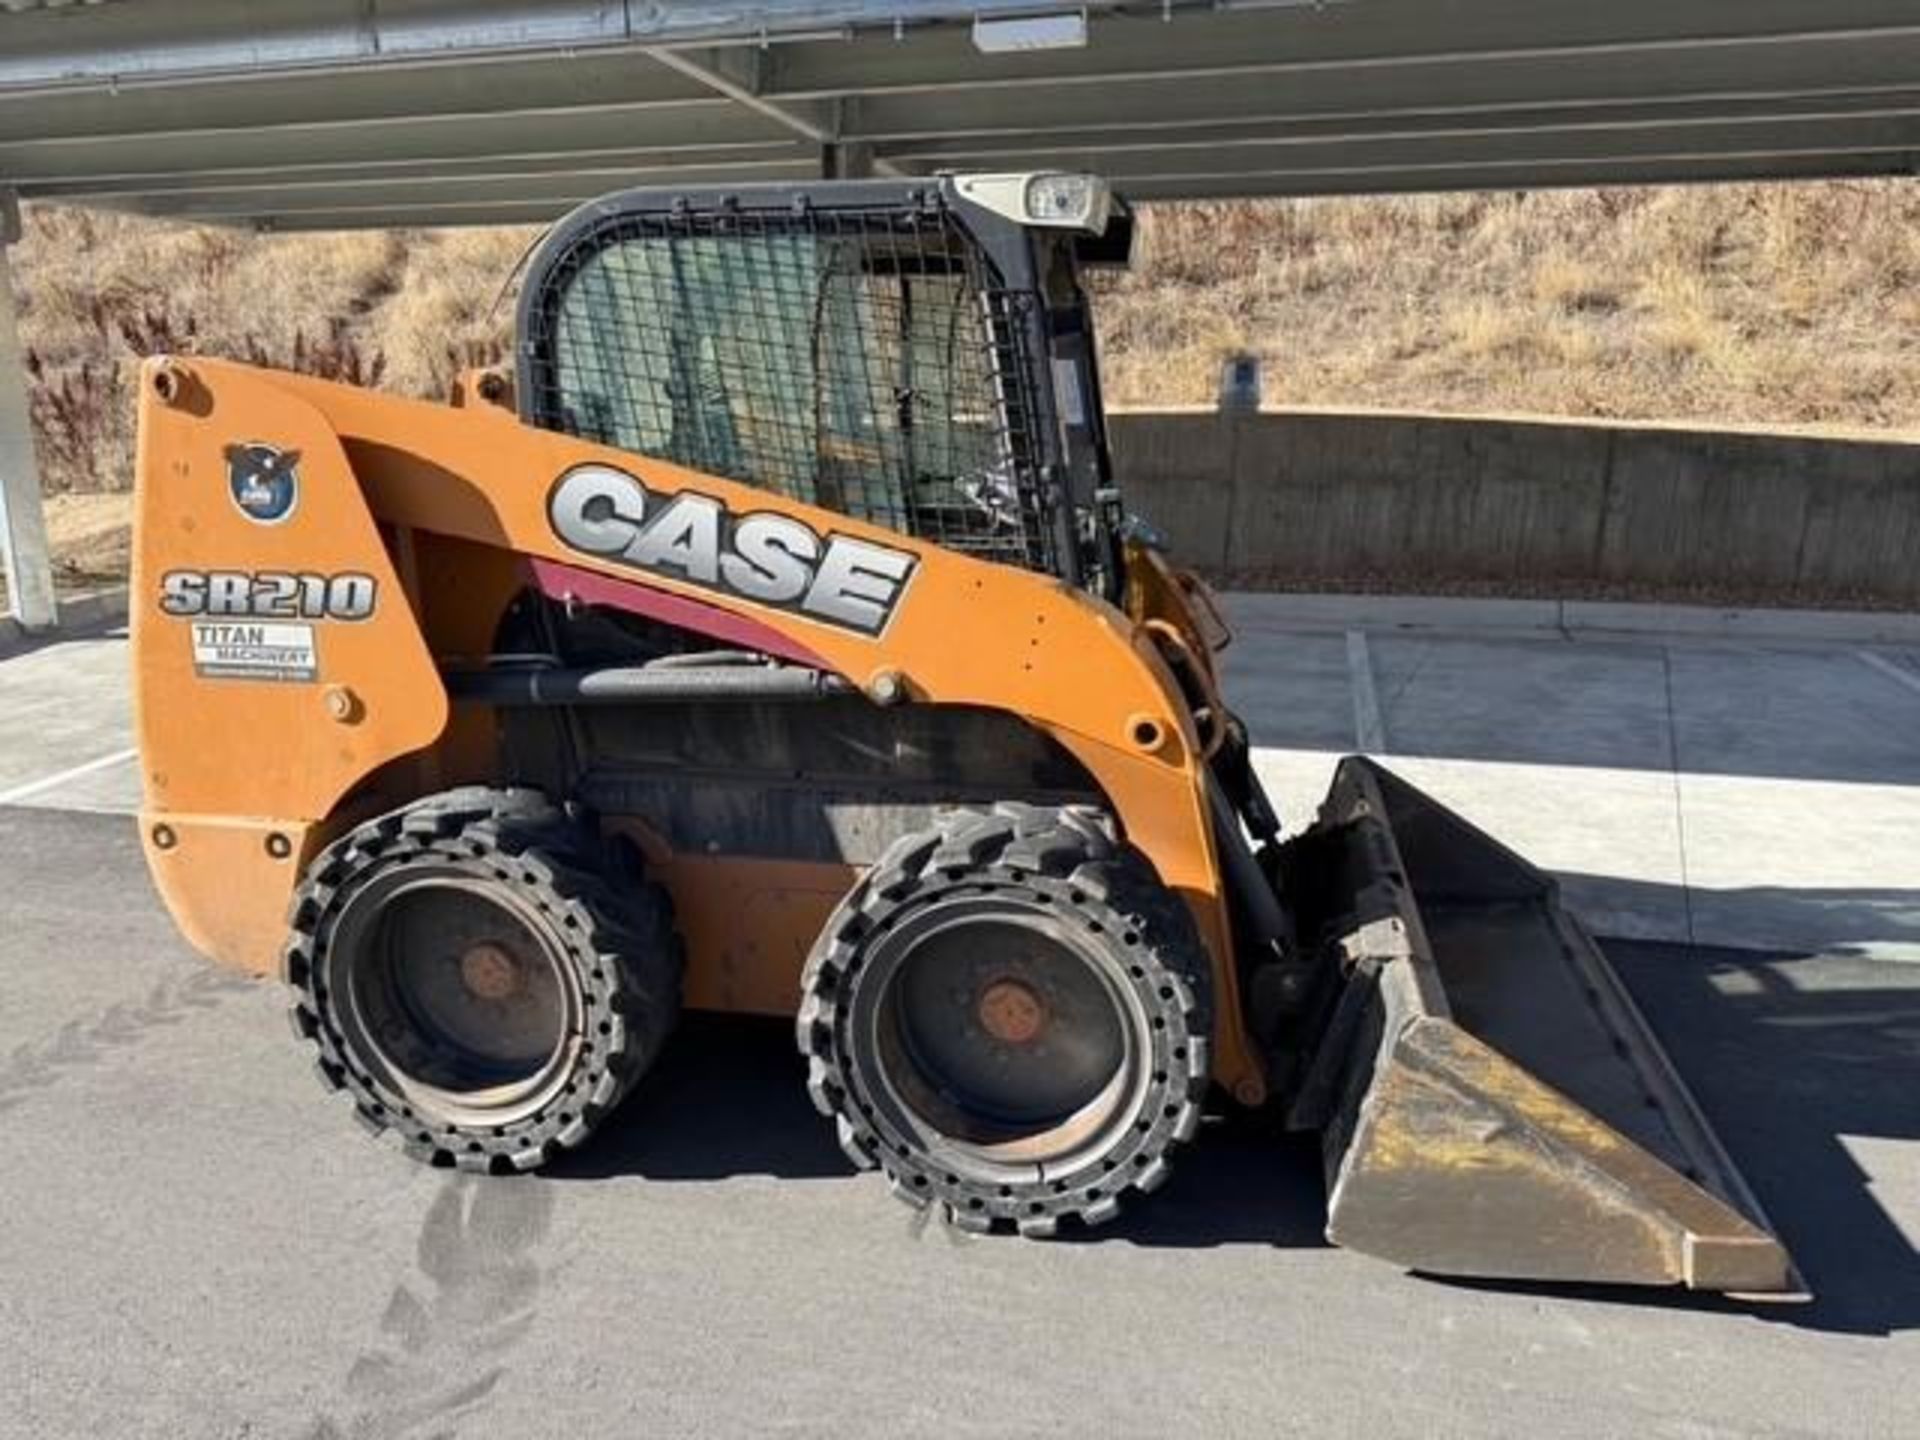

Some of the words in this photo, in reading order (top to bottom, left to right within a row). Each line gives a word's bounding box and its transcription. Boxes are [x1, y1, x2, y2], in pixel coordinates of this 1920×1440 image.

[548, 463, 919, 635] CASE
[160, 569, 376, 621] SR210
[196, 626, 264, 644] TITAN
[216, 648, 309, 663] MACHINERY
